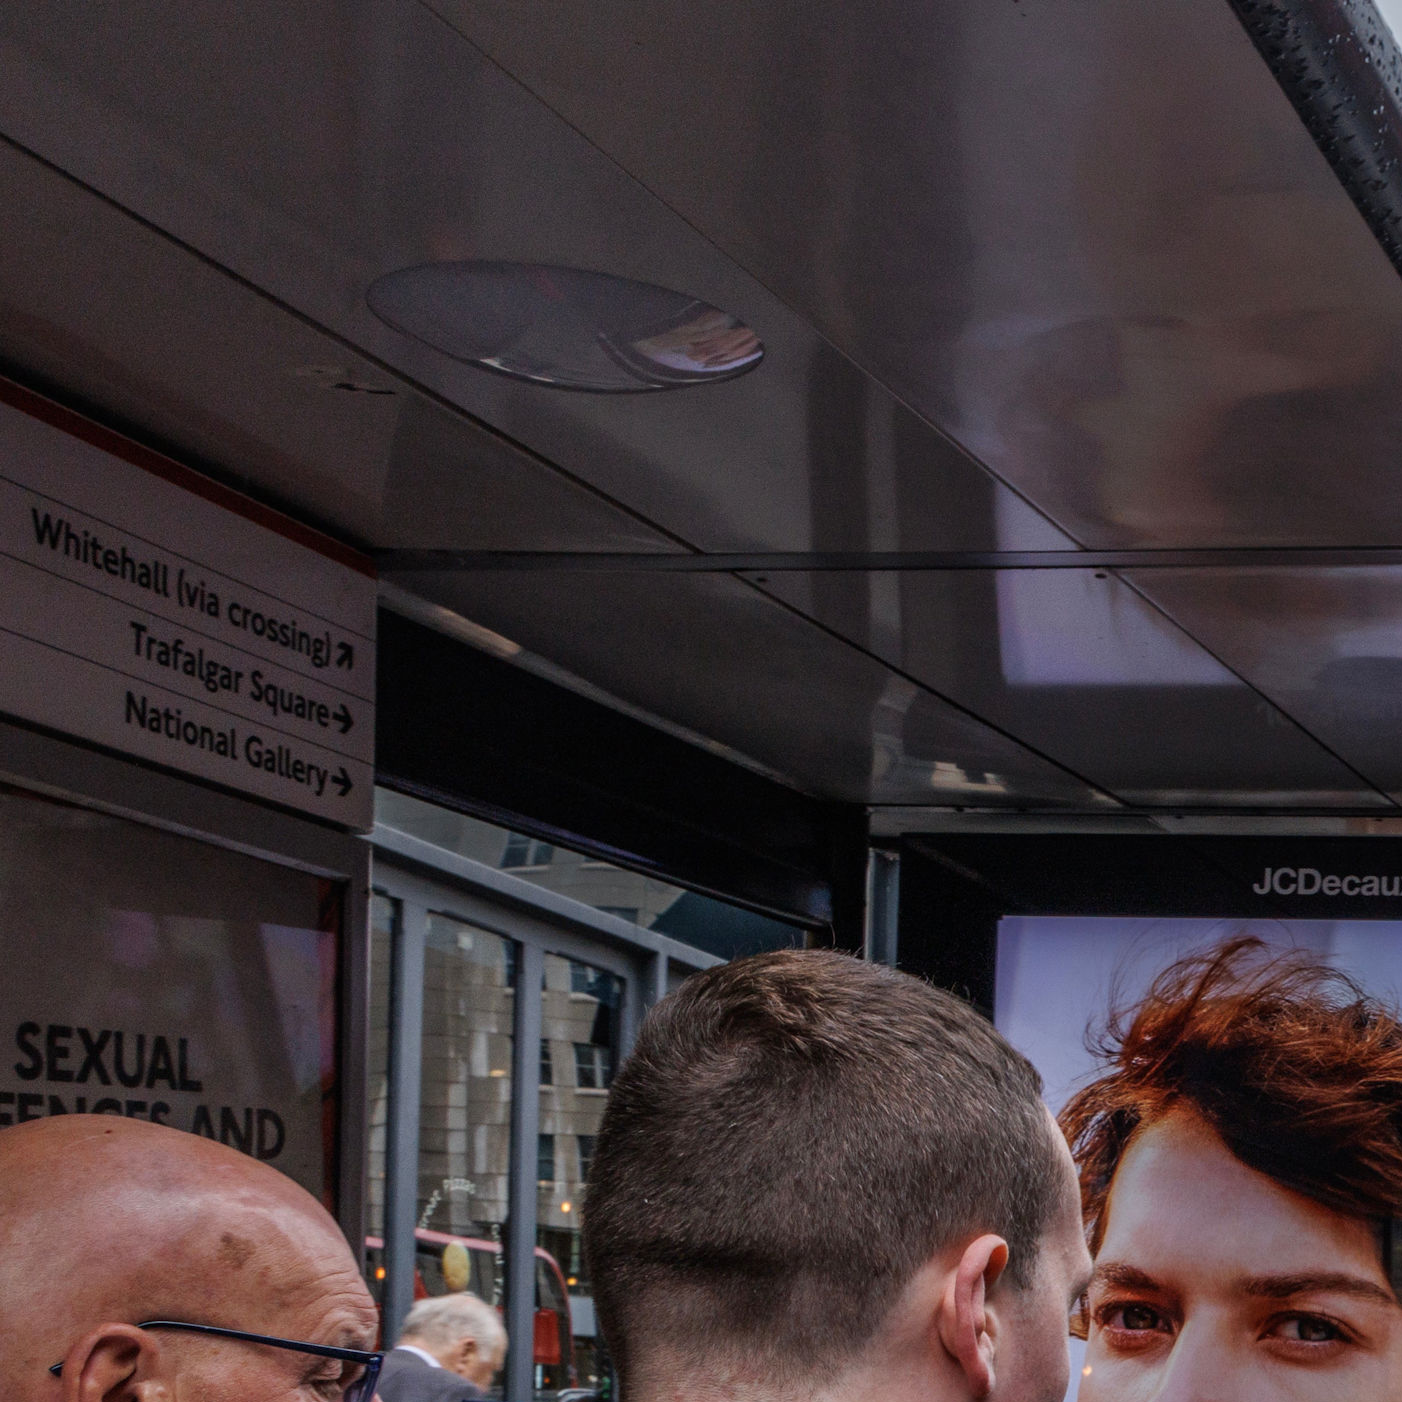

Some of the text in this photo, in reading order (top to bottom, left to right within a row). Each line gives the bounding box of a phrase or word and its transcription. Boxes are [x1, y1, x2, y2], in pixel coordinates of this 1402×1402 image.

[32, 507, 332, 668] Whitehall (via crossing)
[129, 620, 331, 727] Trafalgar Square
[124, 690, 328, 797] National Gallery
[14, 1021, 203, 1093] SEXUAL
[189, 1104, 287, 1161] AND
